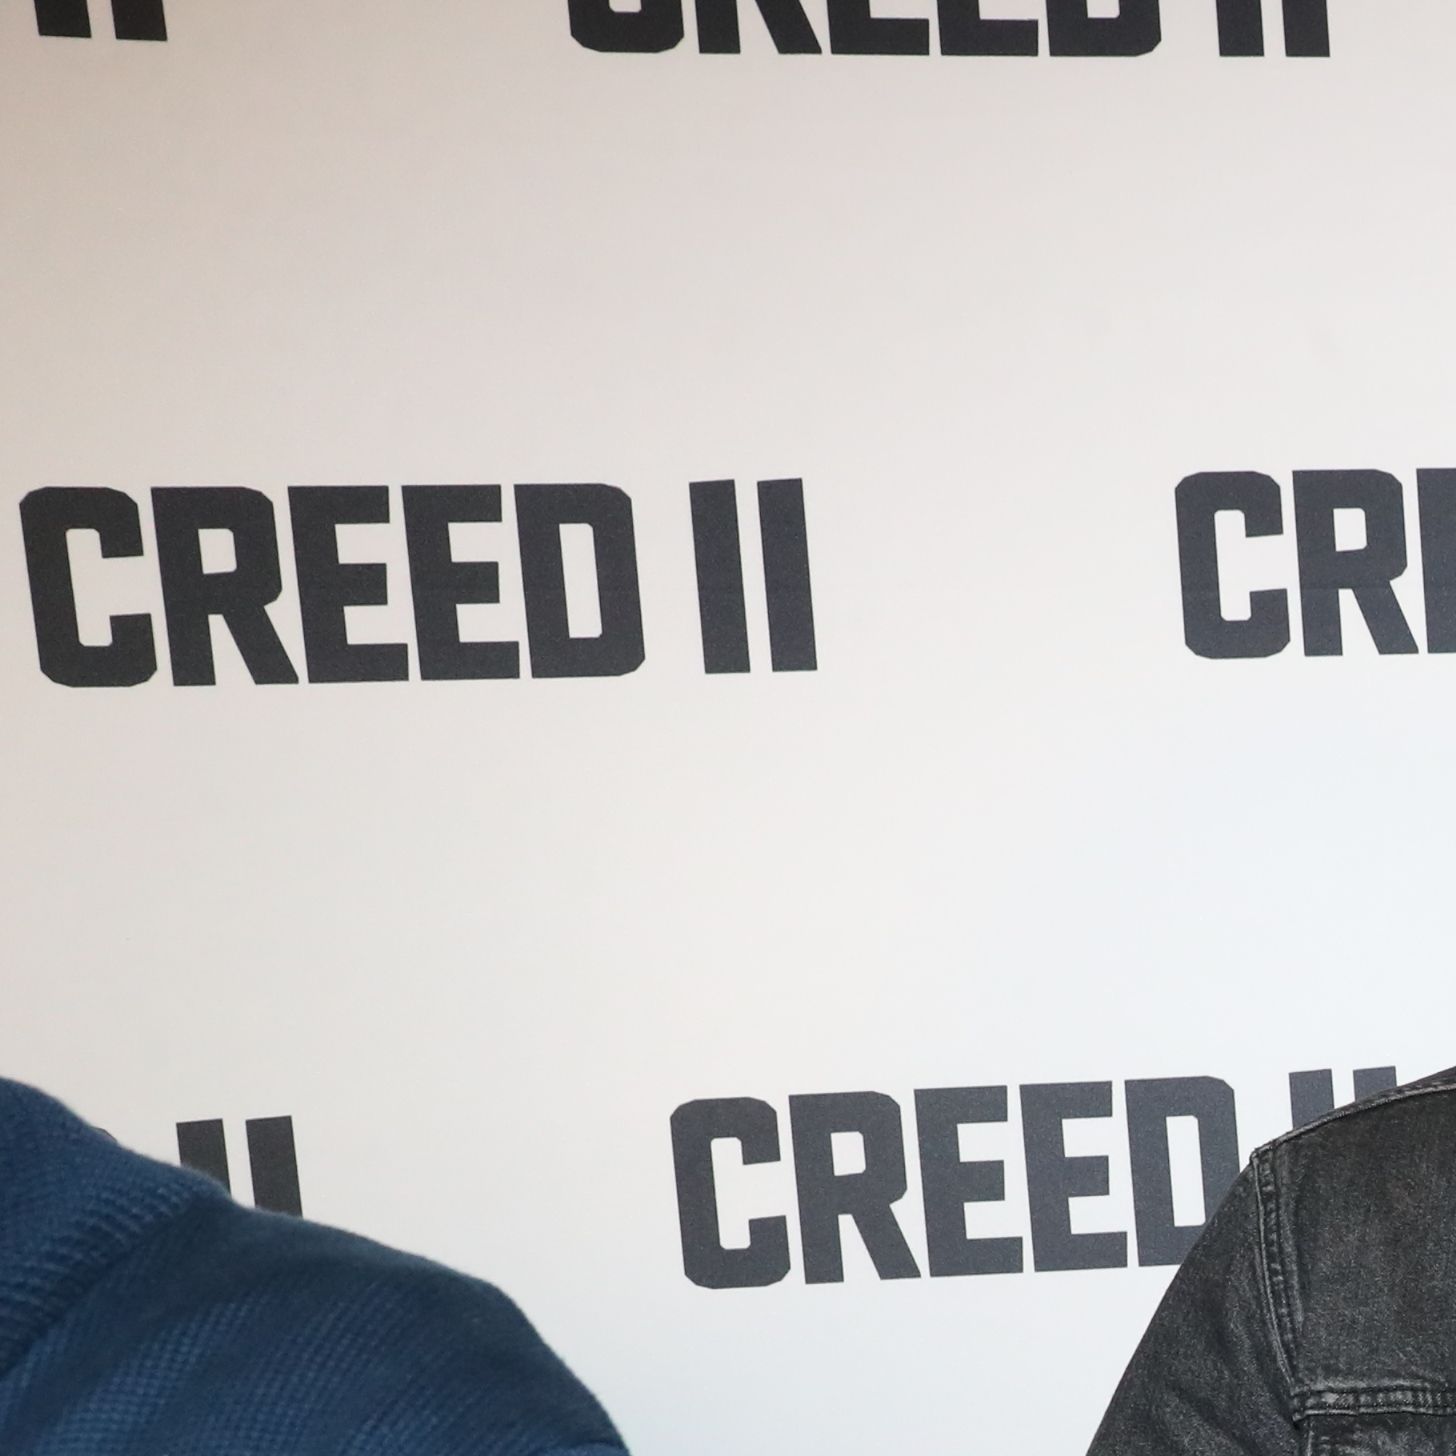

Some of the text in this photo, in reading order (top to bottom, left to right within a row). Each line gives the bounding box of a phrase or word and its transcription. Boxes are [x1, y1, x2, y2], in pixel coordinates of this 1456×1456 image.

[19, 478, 818, 688] CREED II
[670, 1075, 1241, 1290] CREED
